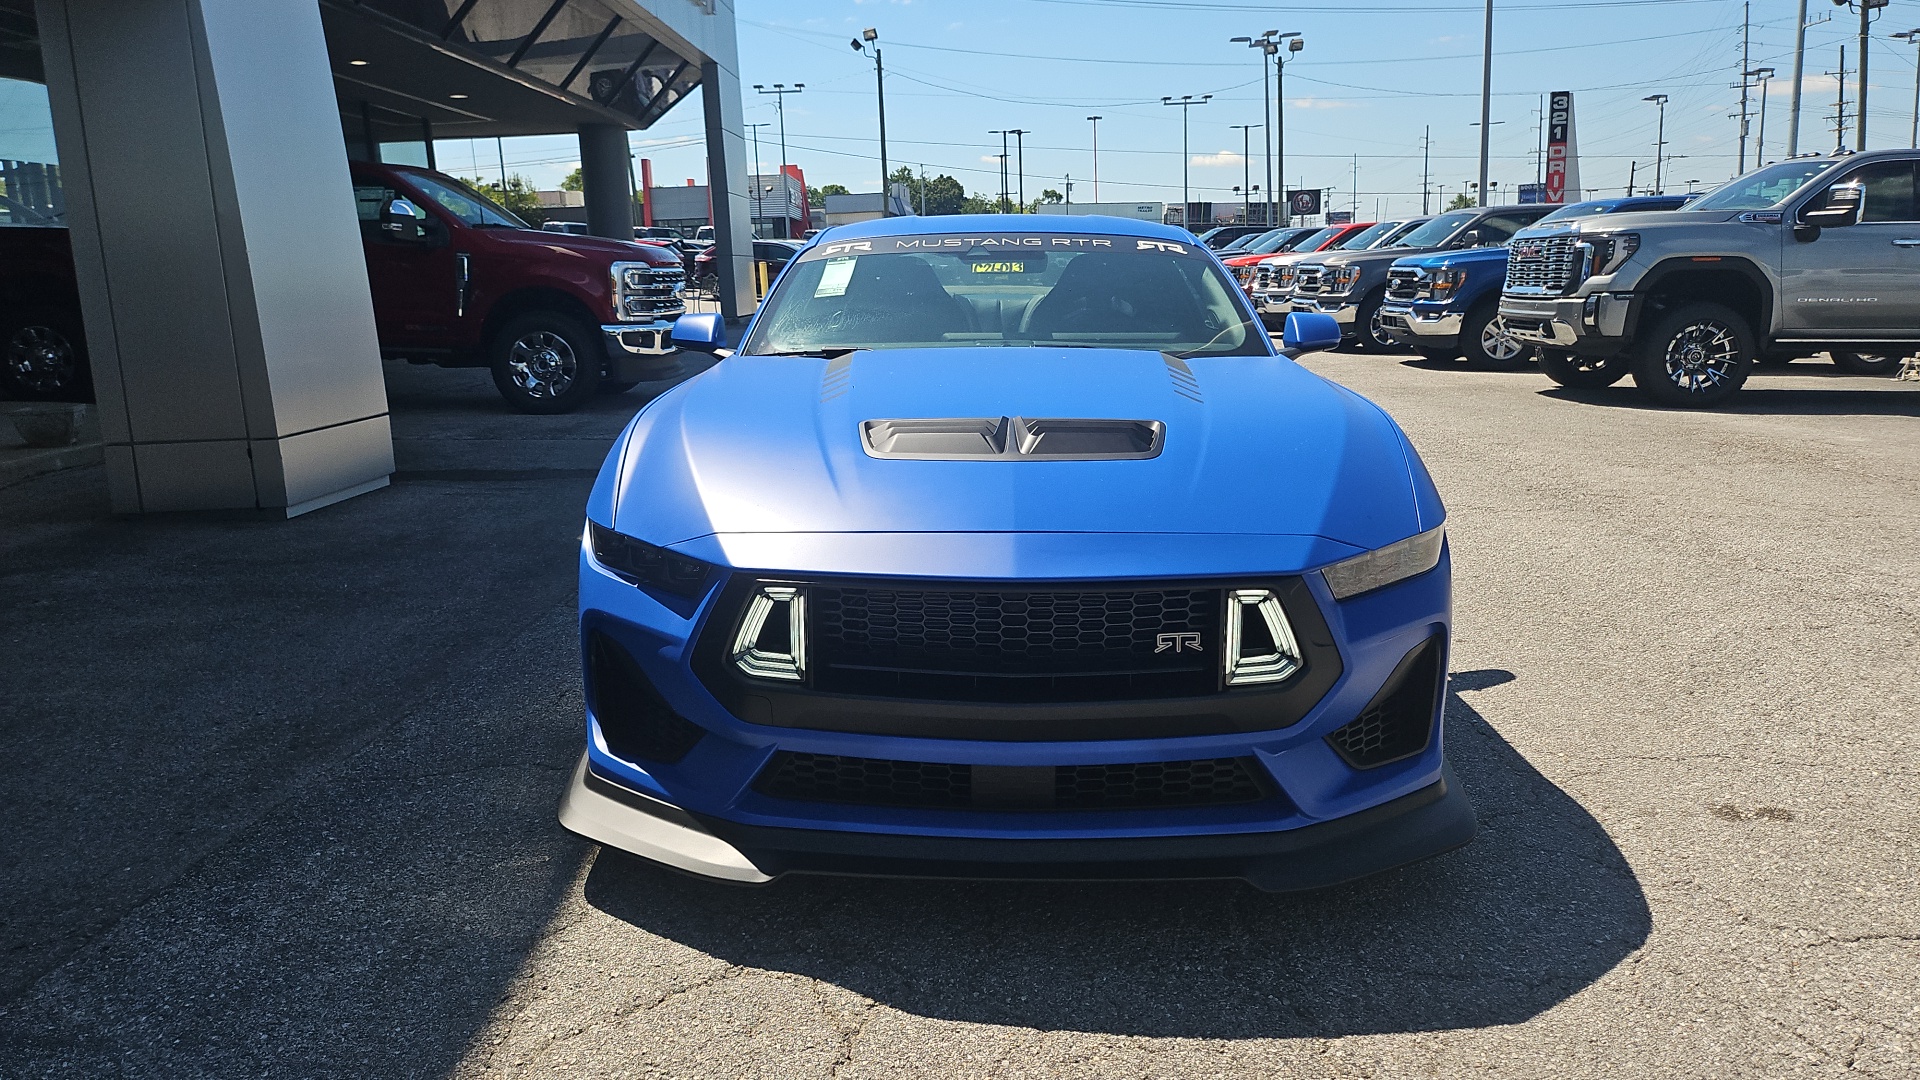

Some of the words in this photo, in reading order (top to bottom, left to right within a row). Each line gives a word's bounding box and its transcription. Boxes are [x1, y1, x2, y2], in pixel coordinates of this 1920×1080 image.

[1552, 96, 1568, 139] 321
[896, 237, 1042, 248] MUSTANG
[1051, 238, 1112, 248] RTR
[1154, 632, 1204, 653] RTR
